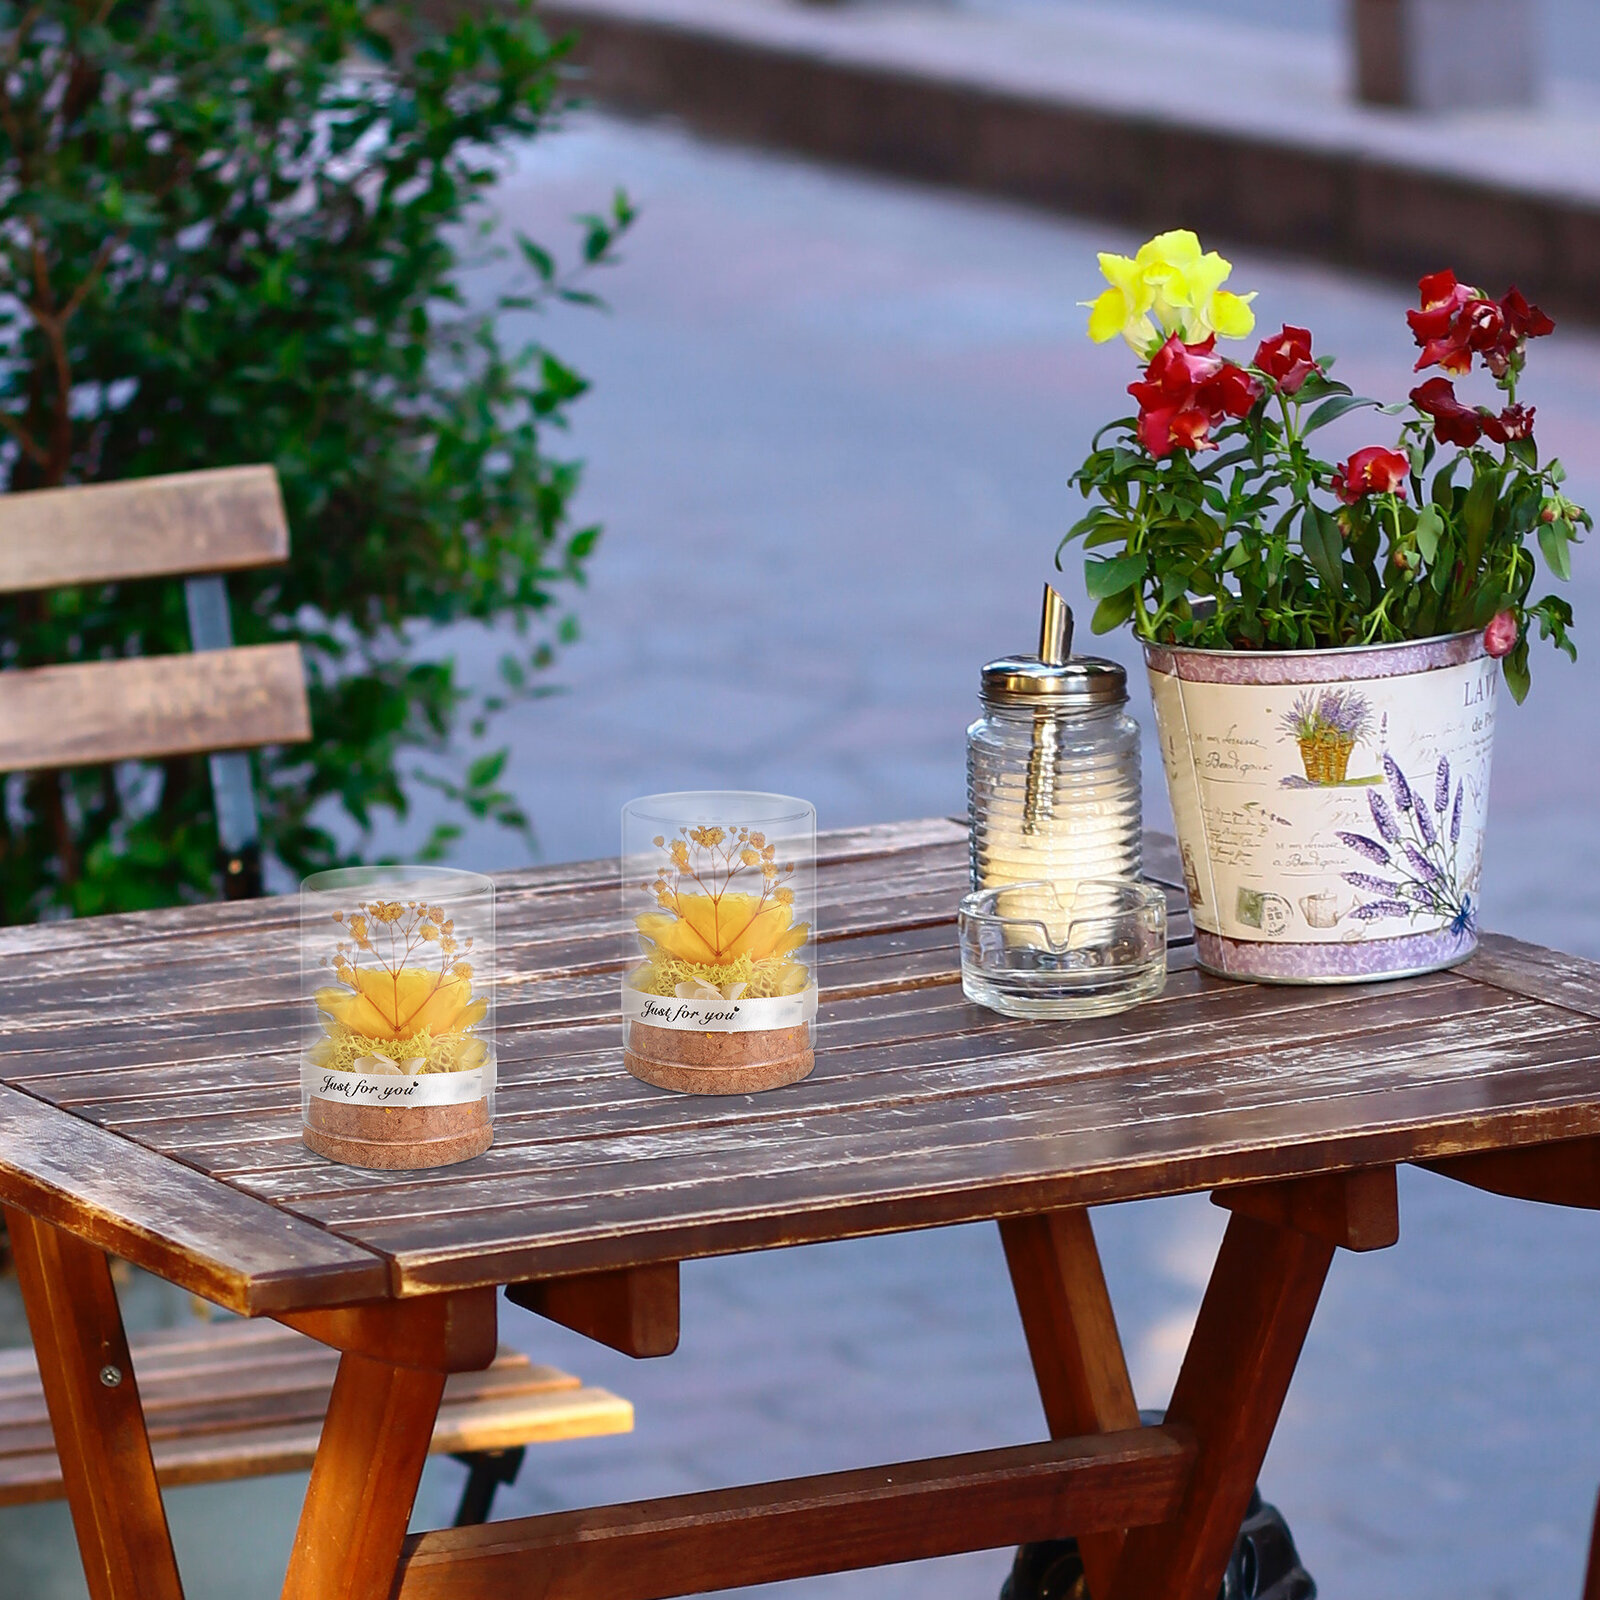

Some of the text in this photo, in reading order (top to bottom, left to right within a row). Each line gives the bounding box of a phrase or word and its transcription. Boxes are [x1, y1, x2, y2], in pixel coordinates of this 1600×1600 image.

[1471, 716, 1483, 733] de
[641, 1000, 735, 1025] Just for you
[319, 1075, 414, 1100] Just for you
